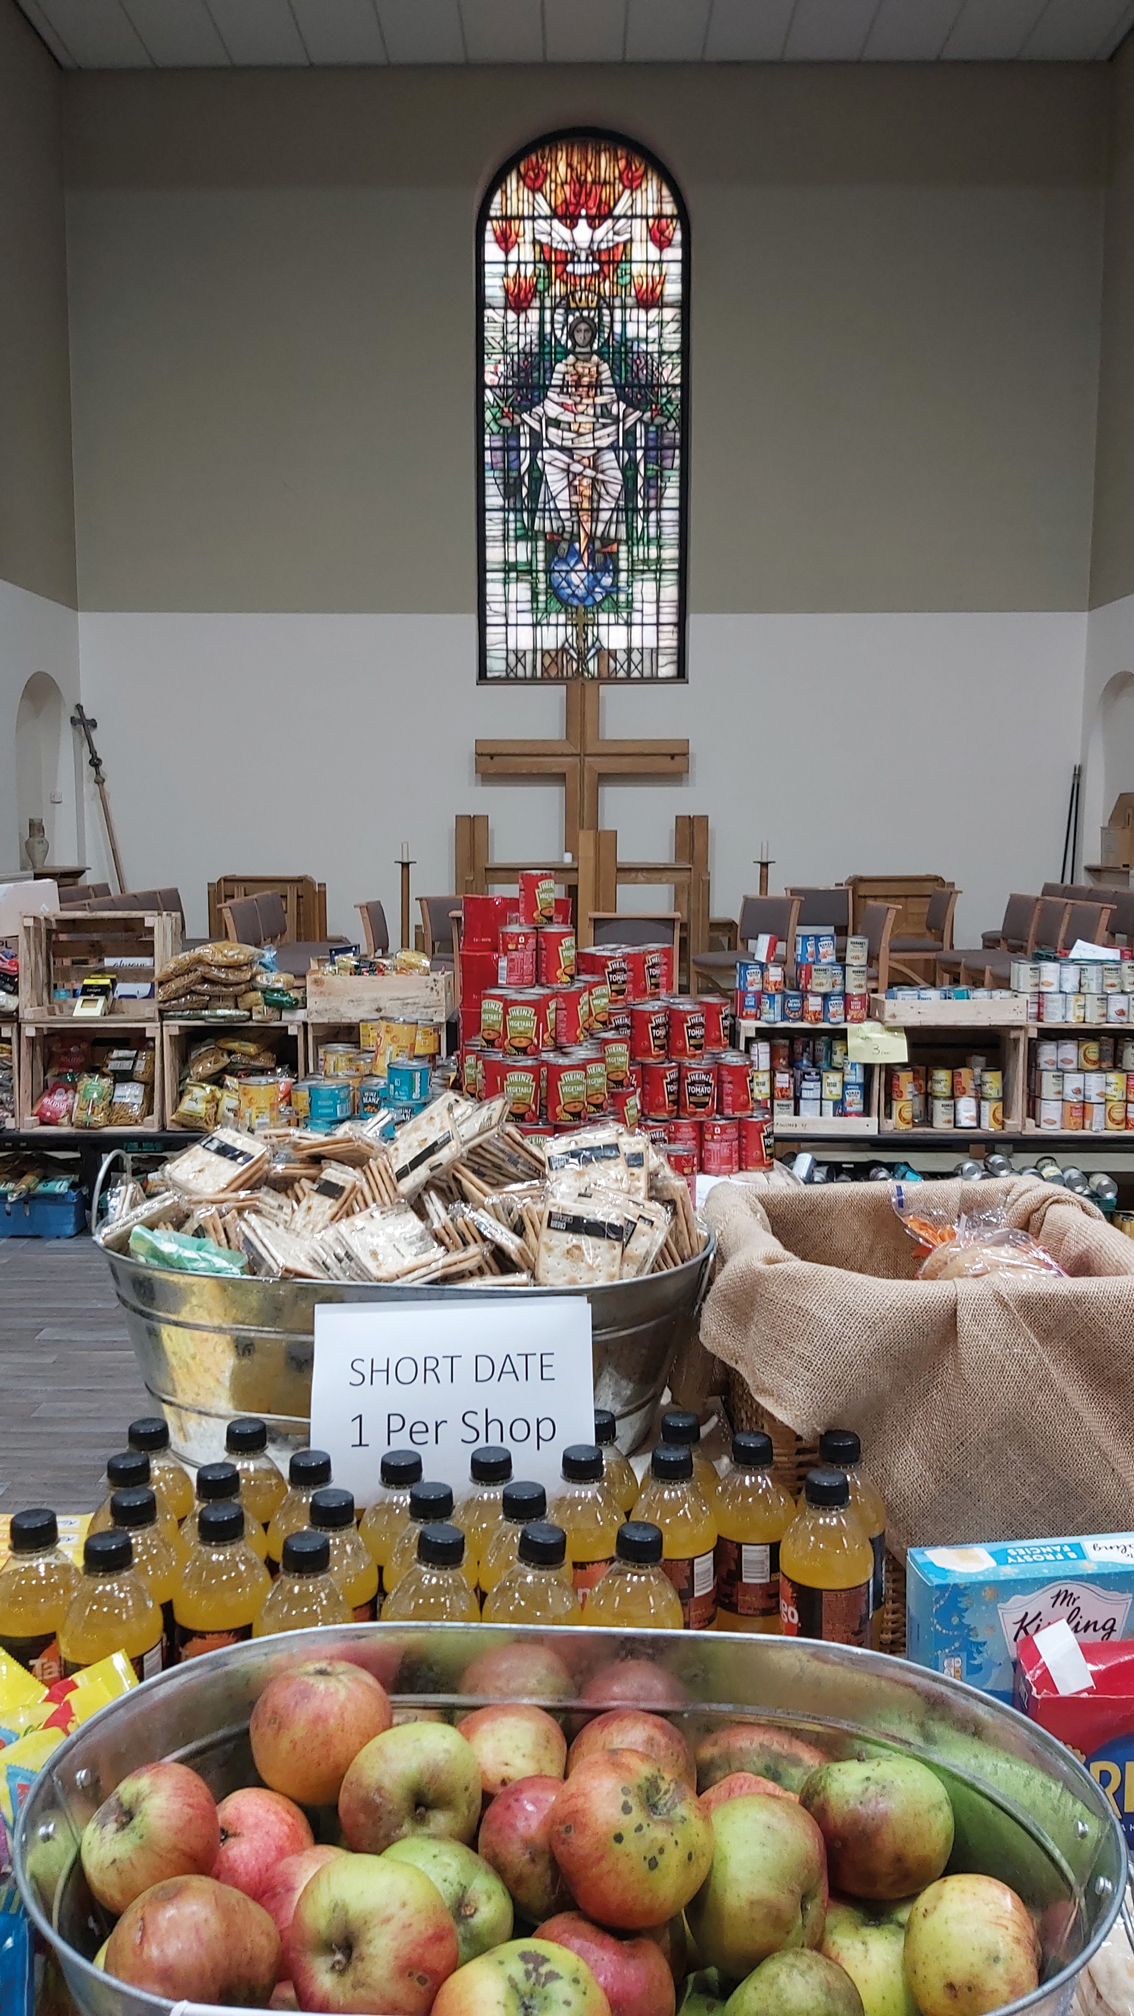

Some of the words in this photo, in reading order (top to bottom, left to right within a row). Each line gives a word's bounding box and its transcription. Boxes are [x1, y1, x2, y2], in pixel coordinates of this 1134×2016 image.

[511, 1008, 532, 1017] HEINZ
[510, 1075, 530, 1083] HEINZ
[690, 1072, 710, 1081] HEINZ
[688, 1085, 711, 1093] TOMATO
[550, 1220, 566, 1230] CREAM
[349, 1354, 462, 1386] SHORT
[474, 1352, 556, 1383] DATE
[350, 1414, 370, 1448] 1
[386, 1412, 448, 1446] Per
[460, 1408, 556, 1451] Shop
[1007, 1544, 1072, 1556] FANCIES
[1007, 1552, 1064, 1563] FROSTY
[1050, 1589, 1080, 1608] Mr
[780, 1600, 799, 1624] go
[1012, 1607, 1118, 1642] Kiling
[29, 1658, 59, 1680] Ta
